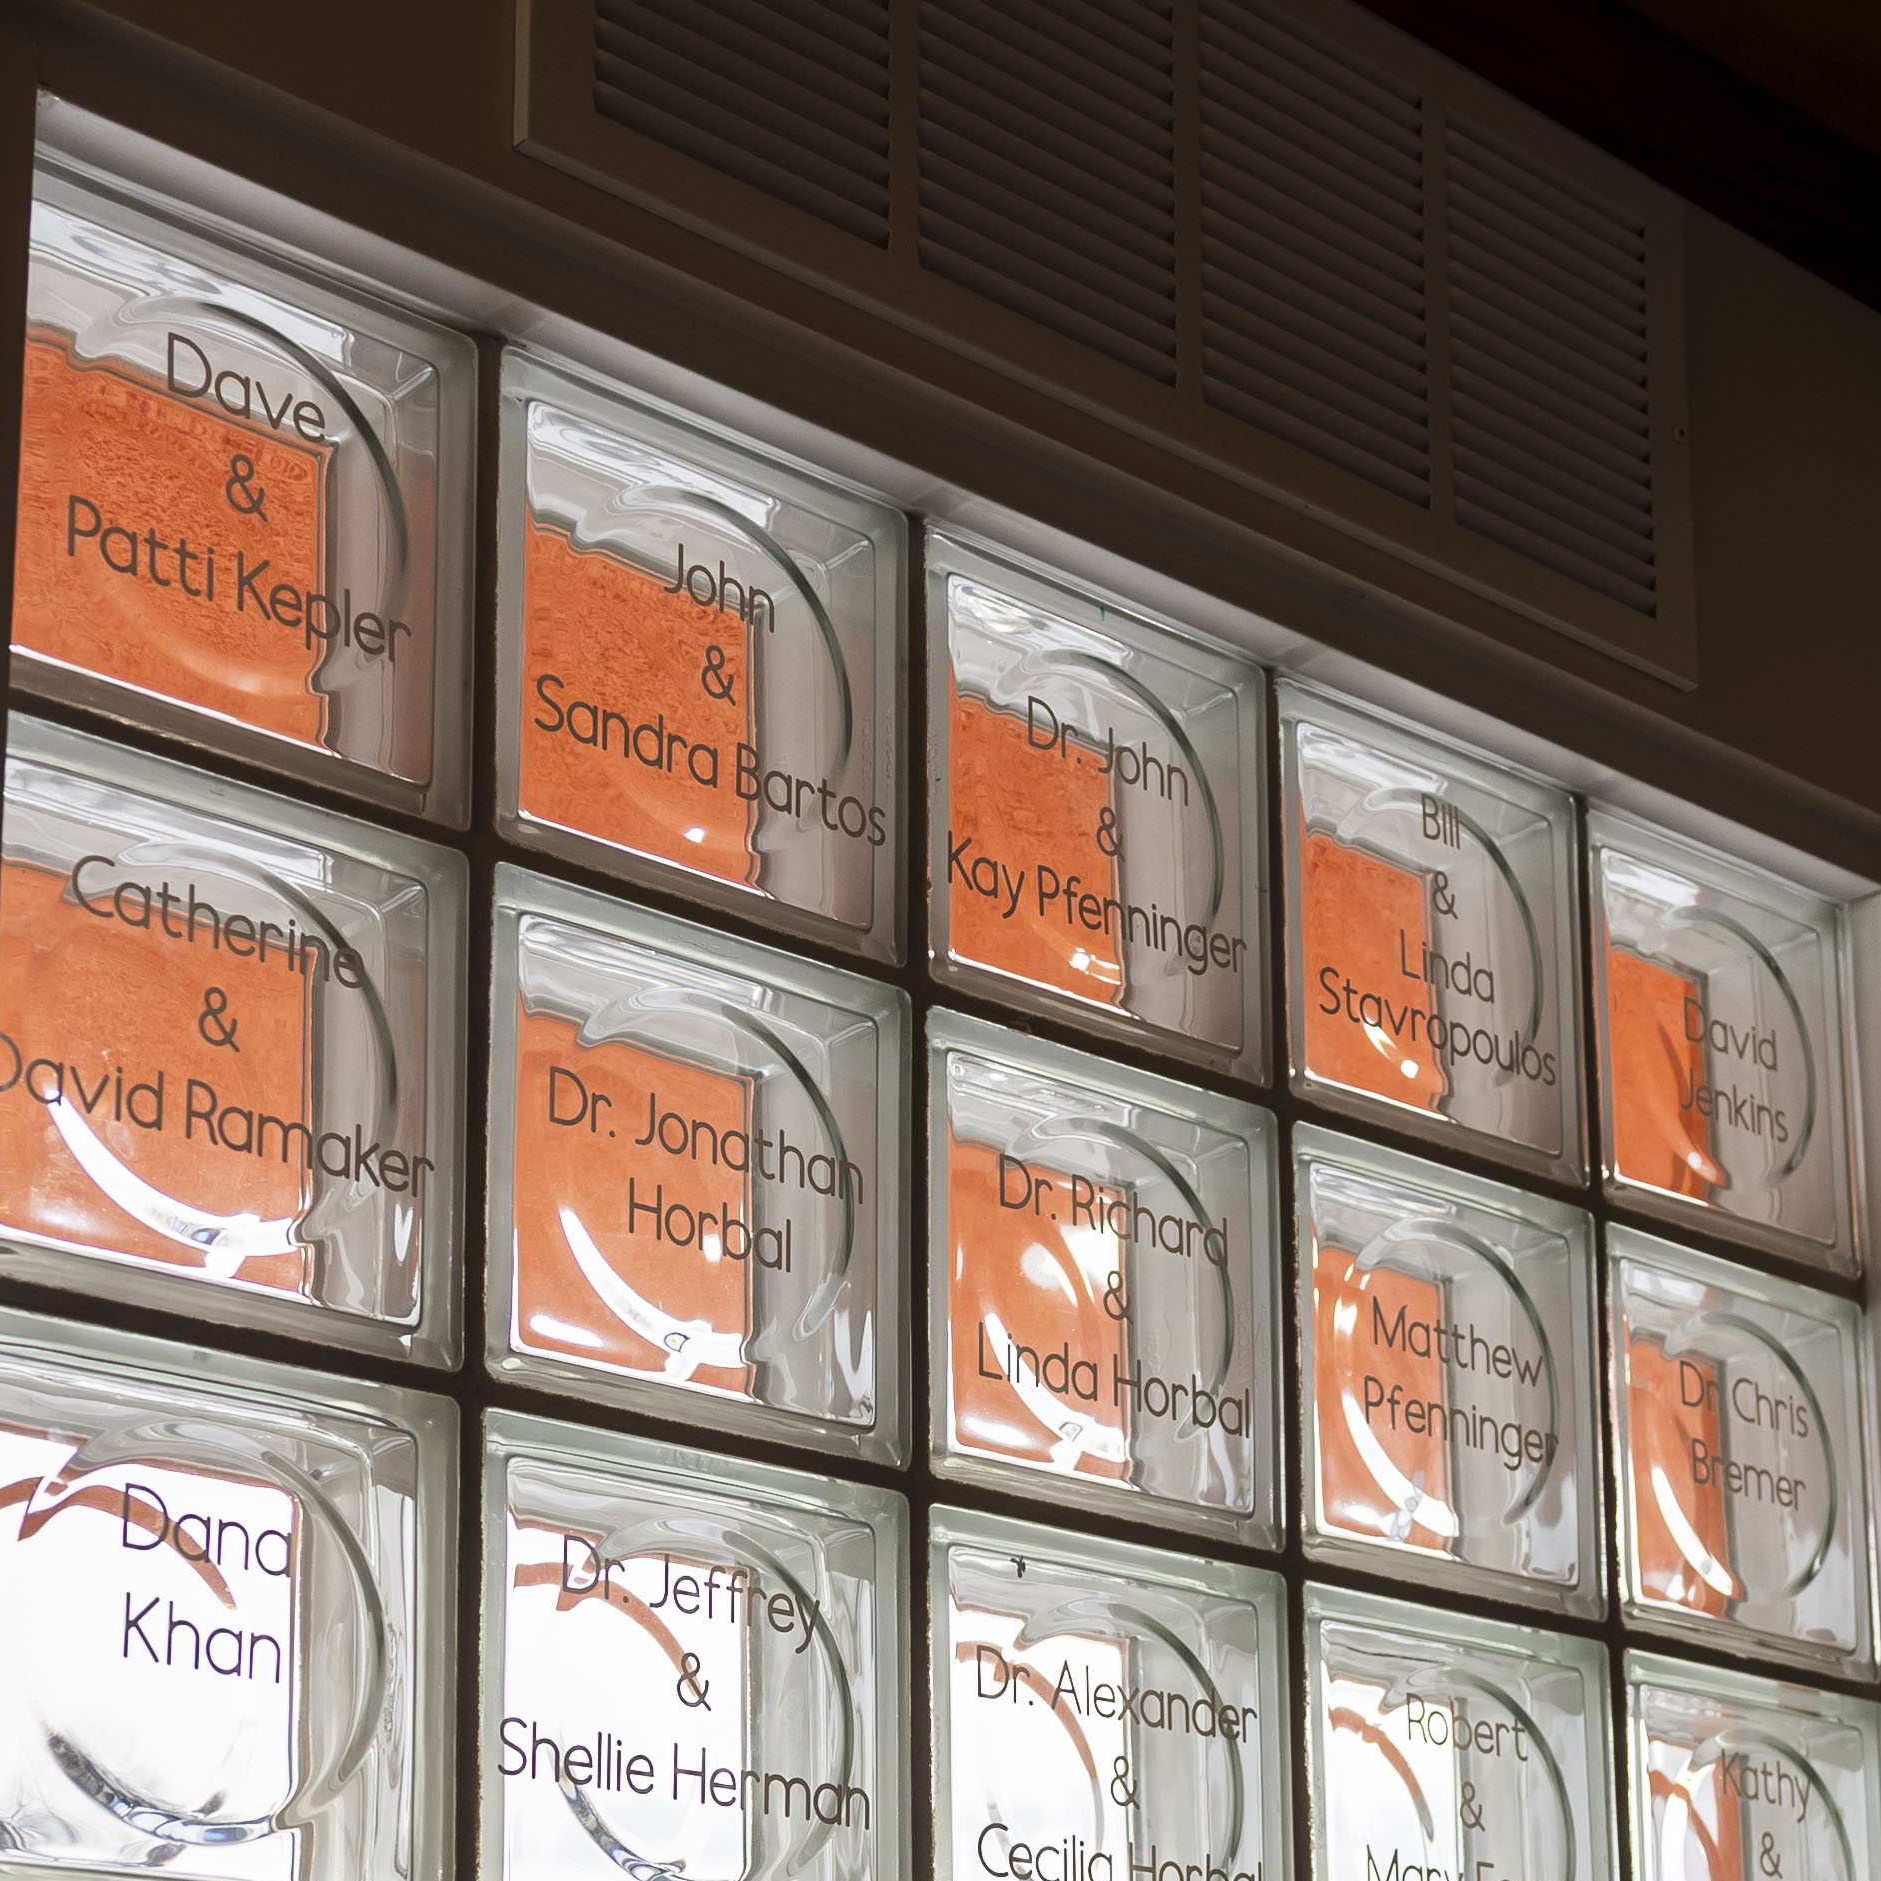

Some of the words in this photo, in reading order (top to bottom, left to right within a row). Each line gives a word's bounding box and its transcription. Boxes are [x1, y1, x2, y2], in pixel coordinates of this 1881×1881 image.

[166, 333, 328, 440] Dave
[224, 454, 268, 521] &
[68, 497, 214, 600] Patti
[238, 548, 411, 665] Kepler
[663, 544, 775, 633] John
[701, 645, 737, 705] &
[535, 676, 719, 789] Sandra
[736, 742, 888, 847] Bartos
[1026, 696, 1082, 765] Dr.
[1099, 726, 1188, 806] John
[1095, 806, 1122, 860] &
[1421, 794, 1461, 850] Bill
[73, 855, 363, 990] Catherine
[946, 831, 1025, 919] Kay
[1037, 867, 1246, 977] Pfenninger
[1431, 870, 1457, 917] &
[1400, 930, 1494, 1005] Linda
[198, 987, 240, 1052] &
[1318, 966, 1556, 1087] Stavropoulos
[1682, 997, 1777, 1072] David
[185, 1081, 434, 1198] Ramaker
[549, 1066, 616, 1139] Dr.
[635, 1092, 864, 1204] Jonathan
[1681, 1068, 1788, 1143] Jenkins
[629, 1178, 792, 1272] Horbal
[999, 1155, 1056, 1224] Dr.
[1070, 1173, 1228, 1268] Richard
[1103, 1270, 1133, 1322] &
[977, 1322, 1099, 1402] Linda
[1112, 1353, 1251, 1438] Horbal
[1371, 1296, 1544, 1387] Matthew
[1362, 1375, 1558, 1472] Pfenninger
[1731, 1377, 1809, 1438] Chris
[1692, 1438, 1806, 1511] Bremer
[122, 1482, 293, 1578] Dana
[562, 1536, 631, 1606] Dr.
[650, 1552, 821, 1654] Jeffrey
[122, 1596, 283, 1684] Khan
[677, 1652, 712, 1712] &
[976, 1645, 1033, 1707] Dr.
[1051, 1660, 1257, 1744] Alexander
[1407, 1694, 1528, 1762] Robert
[498, 1717, 654, 1797] Shellie
[673, 1742, 871, 1830] Herman
[1111, 1757, 1141, 1808] &
[1459, 1782, 1486, 1831] &
[1723, 1749, 1811, 1824] Kathy
[1759, 1832, 1783, 1878] &
